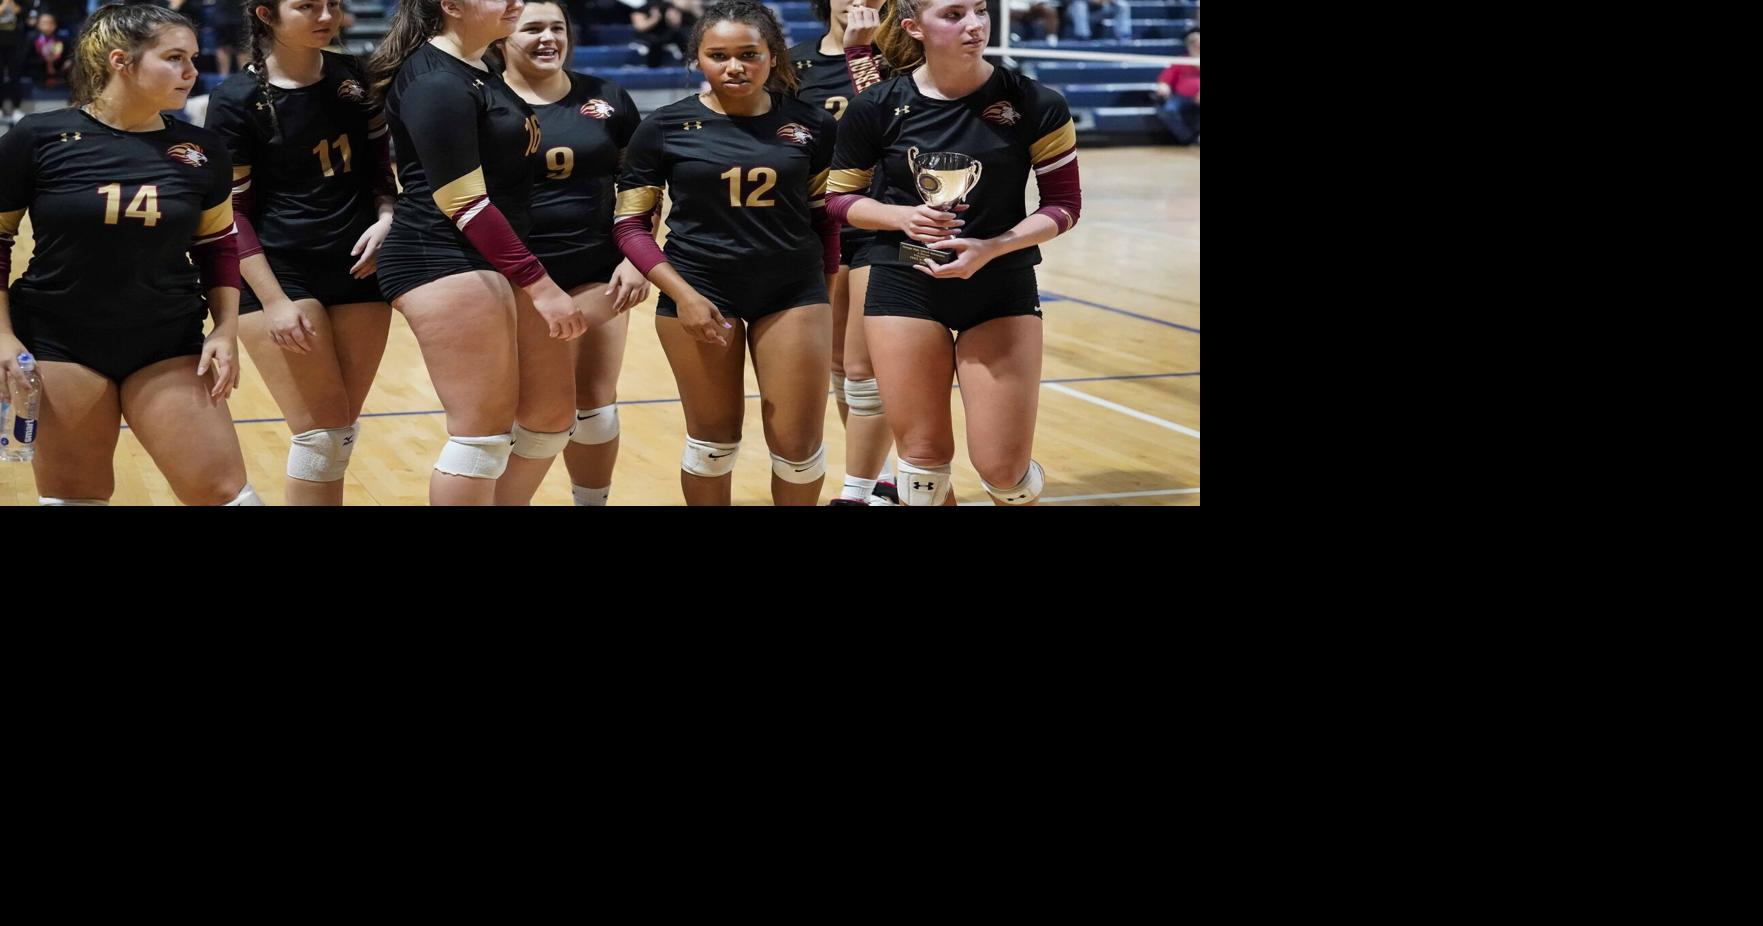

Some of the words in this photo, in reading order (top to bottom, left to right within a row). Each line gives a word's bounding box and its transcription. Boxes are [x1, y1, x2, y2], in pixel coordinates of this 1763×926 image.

[312, 133, 352, 177] 11
[545, 146, 575, 180] 9
[97, 182, 162, 227] 14
[720, 165, 777, 207] 12
